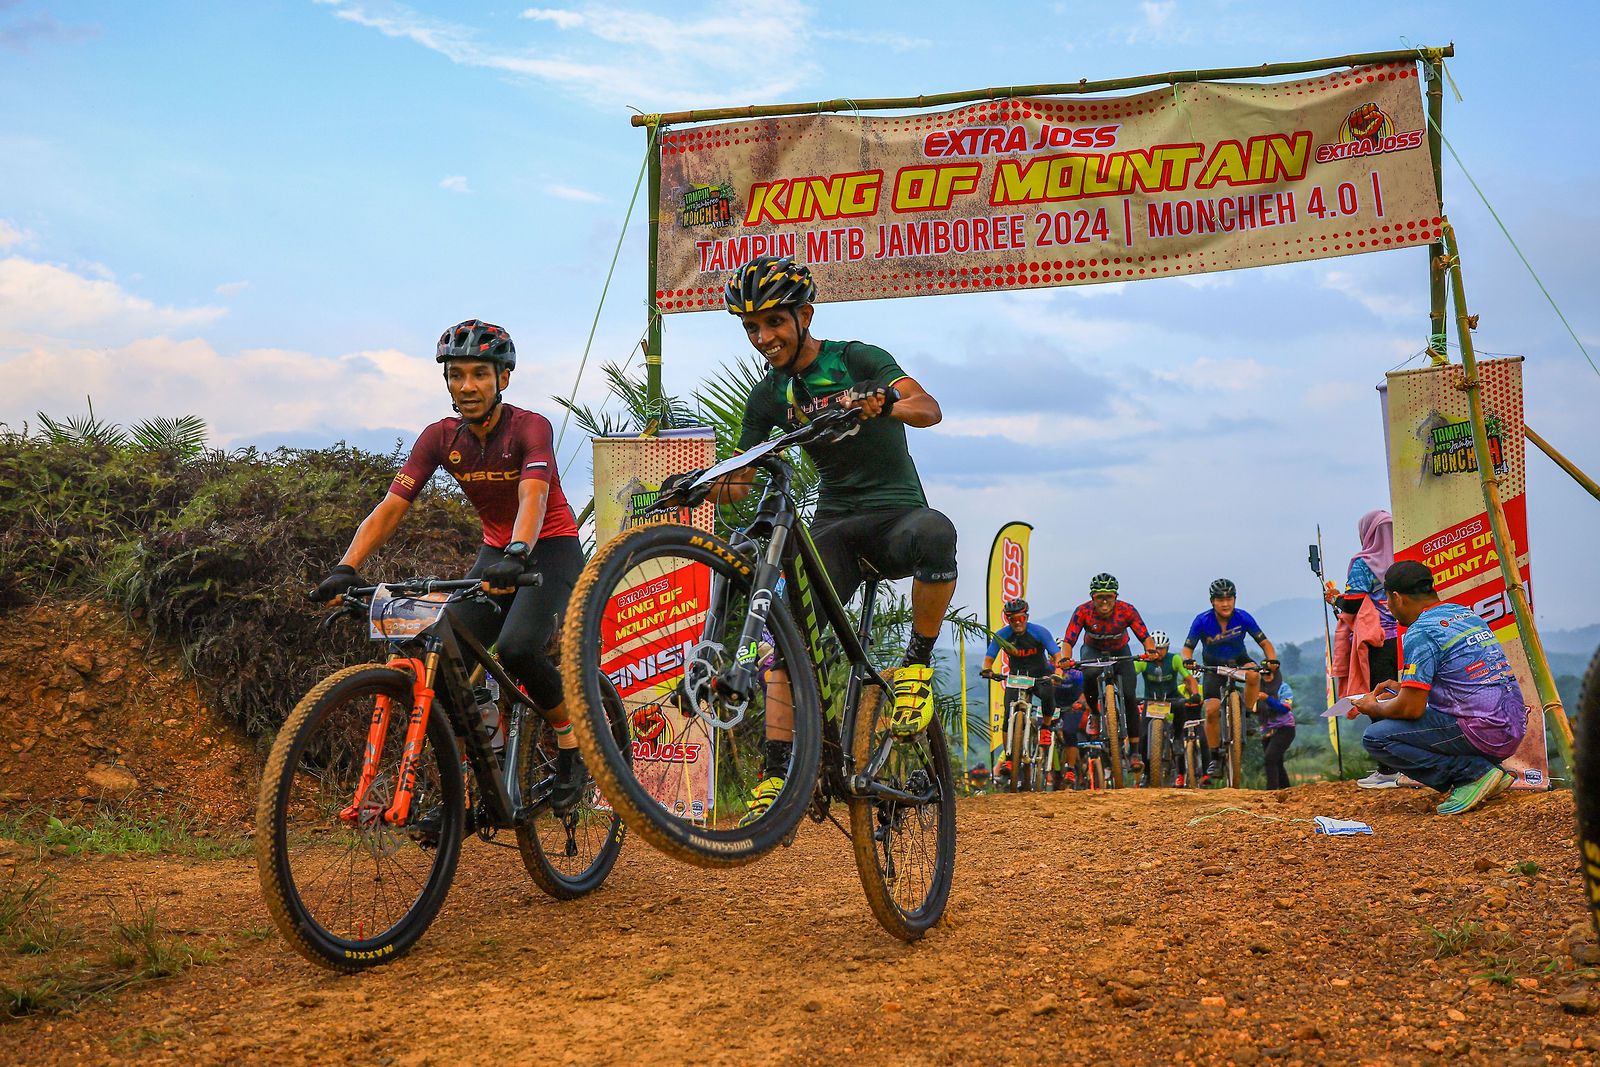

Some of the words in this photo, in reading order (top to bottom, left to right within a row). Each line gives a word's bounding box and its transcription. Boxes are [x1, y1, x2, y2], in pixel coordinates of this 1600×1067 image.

[923, 125, 1027, 158] EXTRA
[1032, 123, 1121, 150] JOSS
[743, 169, 884, 226] KING
[892, 162, 983, 213] OF
[989, 131, 1313, 206] MOUNTAIN
[684, 188, 710, 204] TAMPIN
[683, 199, 730, 227] MONCHEH
[695, 232, 796, 273] TAMPIN
[806, 227, 866, 264] MTB
[873, 214, 1027, 259] JAMBOREE
[1035, 206, 1111, 248] 2024
[1147, 190, 1298, 240] MONCHEH
[1307, 181, 1359, 220] 4.0
[1432, 422, 1472, 443] TAMPIN
[1436, 442, 1451, 451] MTB
[1449, 438, 1474, 453] Jambo
[1433, 437, 1502, 475] MONCHH
[632, 491, 661, 508] TAMP
[689, 536, 751, 575] MAXXIS
[1422, 543, 1467, 569] KING
[1432, 540, 1517, 587] OUNTA
[615, 598, 698, 641] MOUNTAIN
[616, 598, 655, 623] KING
[659, 587, 683, 605] OF
[614, 817, 625, 844] XIS
[344, 943, 394, 960] MAXXIS
